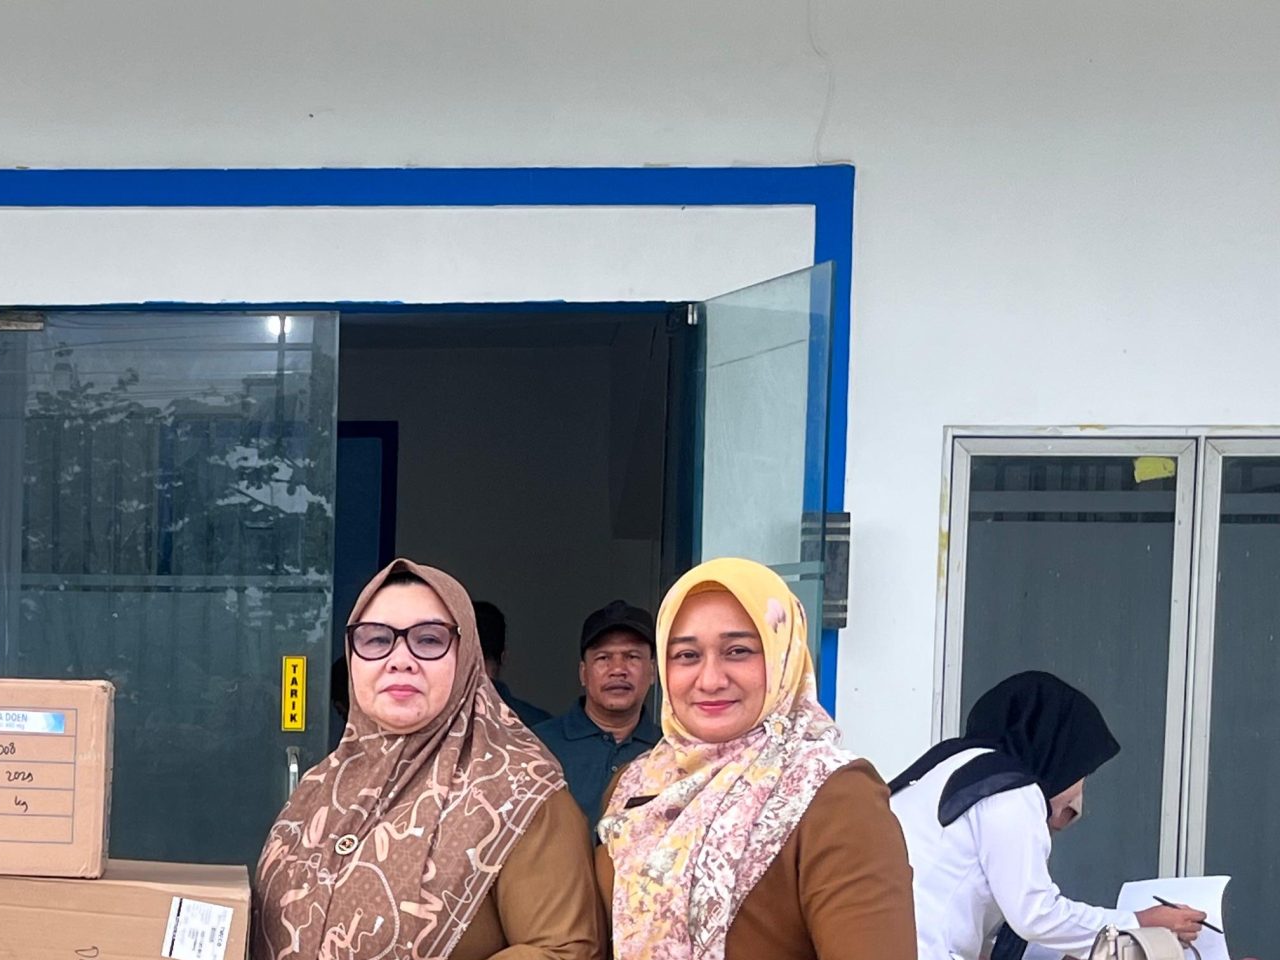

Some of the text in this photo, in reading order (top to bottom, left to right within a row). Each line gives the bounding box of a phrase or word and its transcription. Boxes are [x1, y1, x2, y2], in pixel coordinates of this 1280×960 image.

[289, 663, 299, 723] TARIK
[5, 713, 28, 723] DOEN
[14, 796, 28, 812] kg
